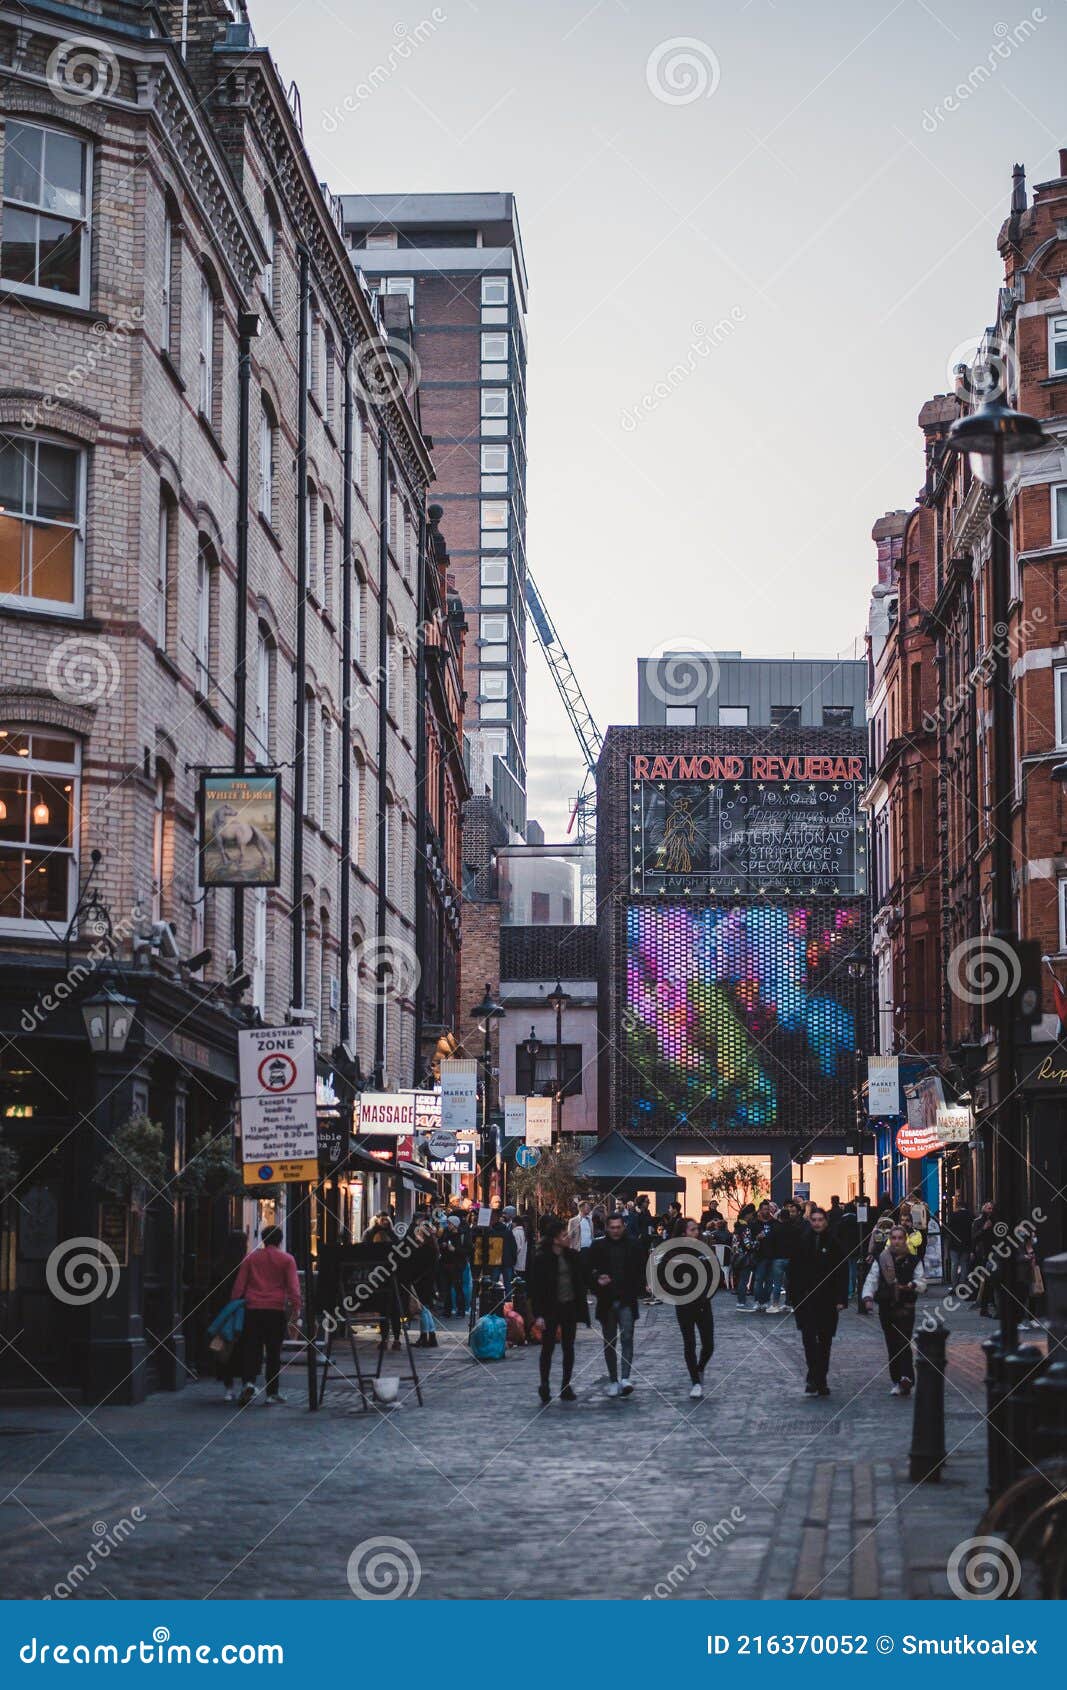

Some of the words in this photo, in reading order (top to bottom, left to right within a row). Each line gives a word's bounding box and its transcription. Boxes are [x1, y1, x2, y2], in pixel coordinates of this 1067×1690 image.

[634, 756, 744, 780] RAYMOND
[752, 756, 863, 780] REVUEBAR
[730, 832, 844, 844] INTERNATIONAL
[750, 848, 832, 860] STRIPTEASE
[740, 860, 840, 873] SPECTACULAR
[663, 877, 698, 886] LAVISH
[703, 877, 737, 886] REVUE
[753, 877, 801, 887] ICENSED
[811, 877, 836, 887] BARS
[250, 1030, 303, 1039] PEDESTRIAN
[257, 1038, 295, 1051] ZONE
[362, 1104, 414, 1123] MASSAGE
[430, 1161, 469, 1171] WINE
